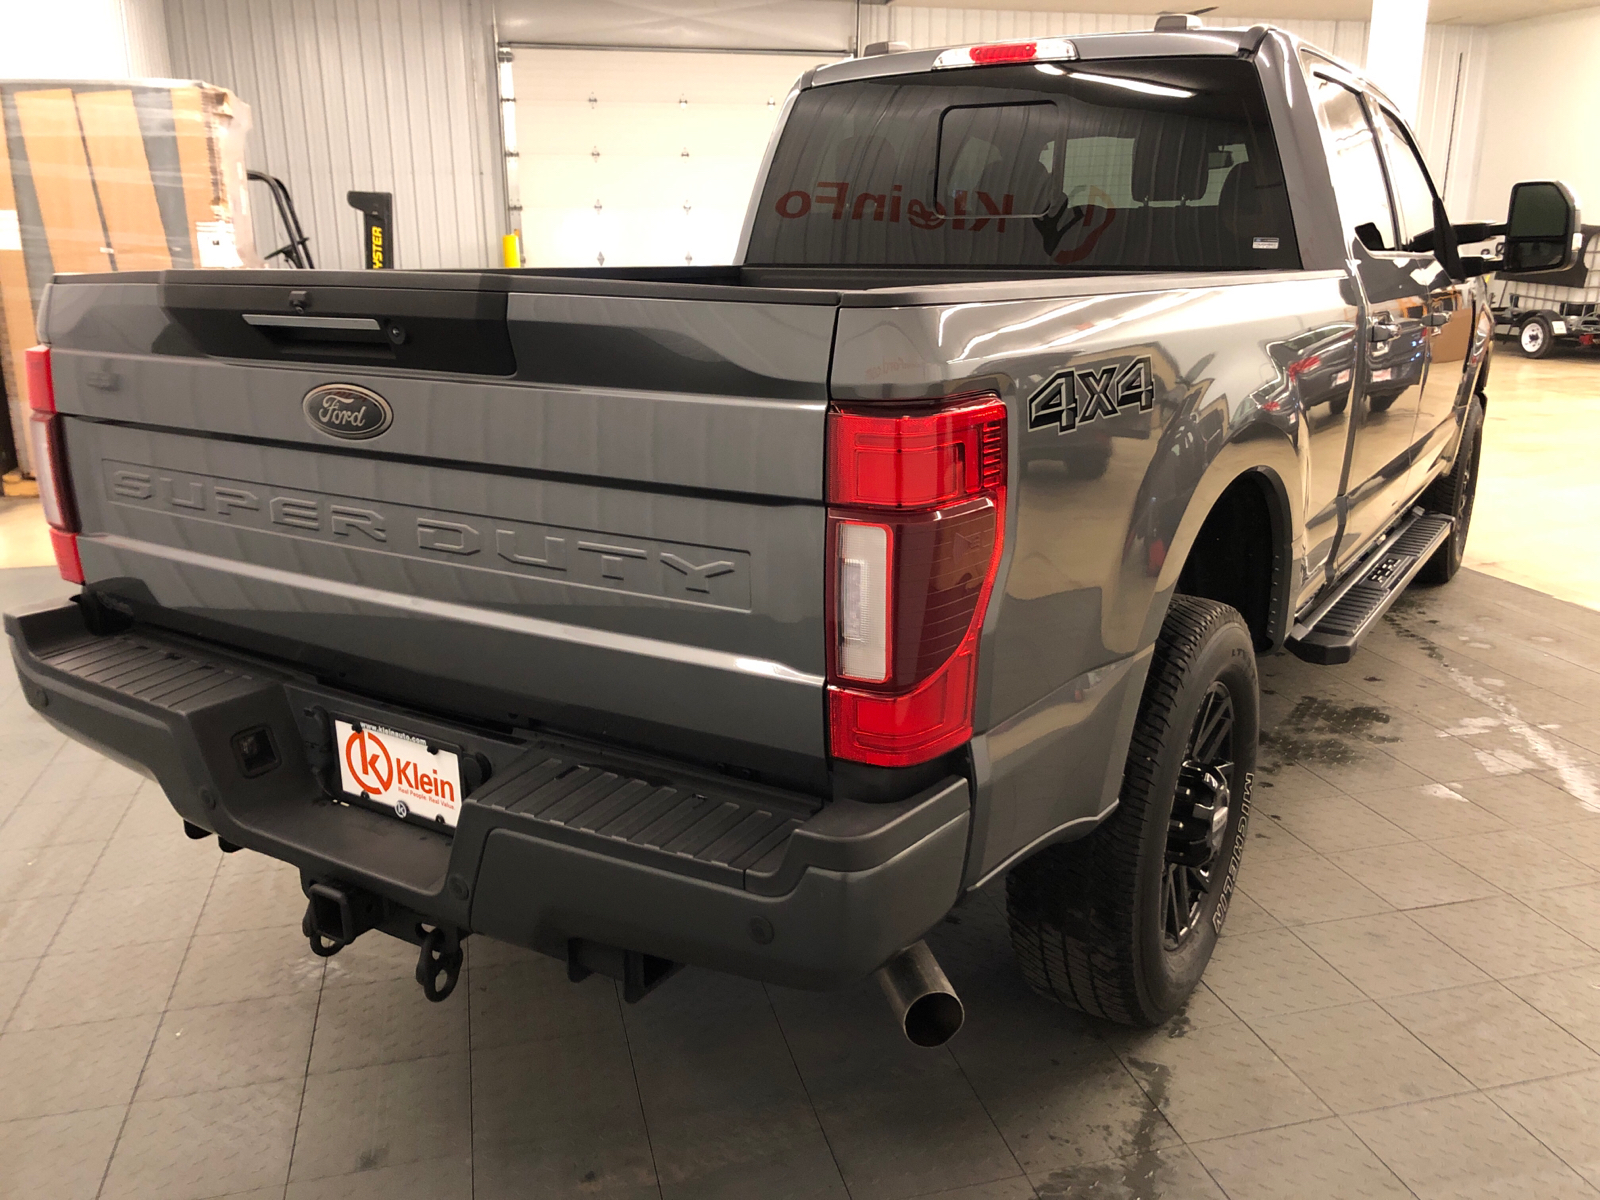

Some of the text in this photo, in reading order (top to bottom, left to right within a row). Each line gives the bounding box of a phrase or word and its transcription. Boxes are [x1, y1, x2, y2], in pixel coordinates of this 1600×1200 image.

[319, 395, 367, 428] Ford
[113, 469, 735, 594] SUPER DUTY
[360, 722, 427, 746] www.kleinauto.com
[396, 758, 454, 802] Klein
[398, 786, 409, 795] Real
[429, 796, 440, 805] Real
[1212, 773, 1254, 934] MICHELIN
